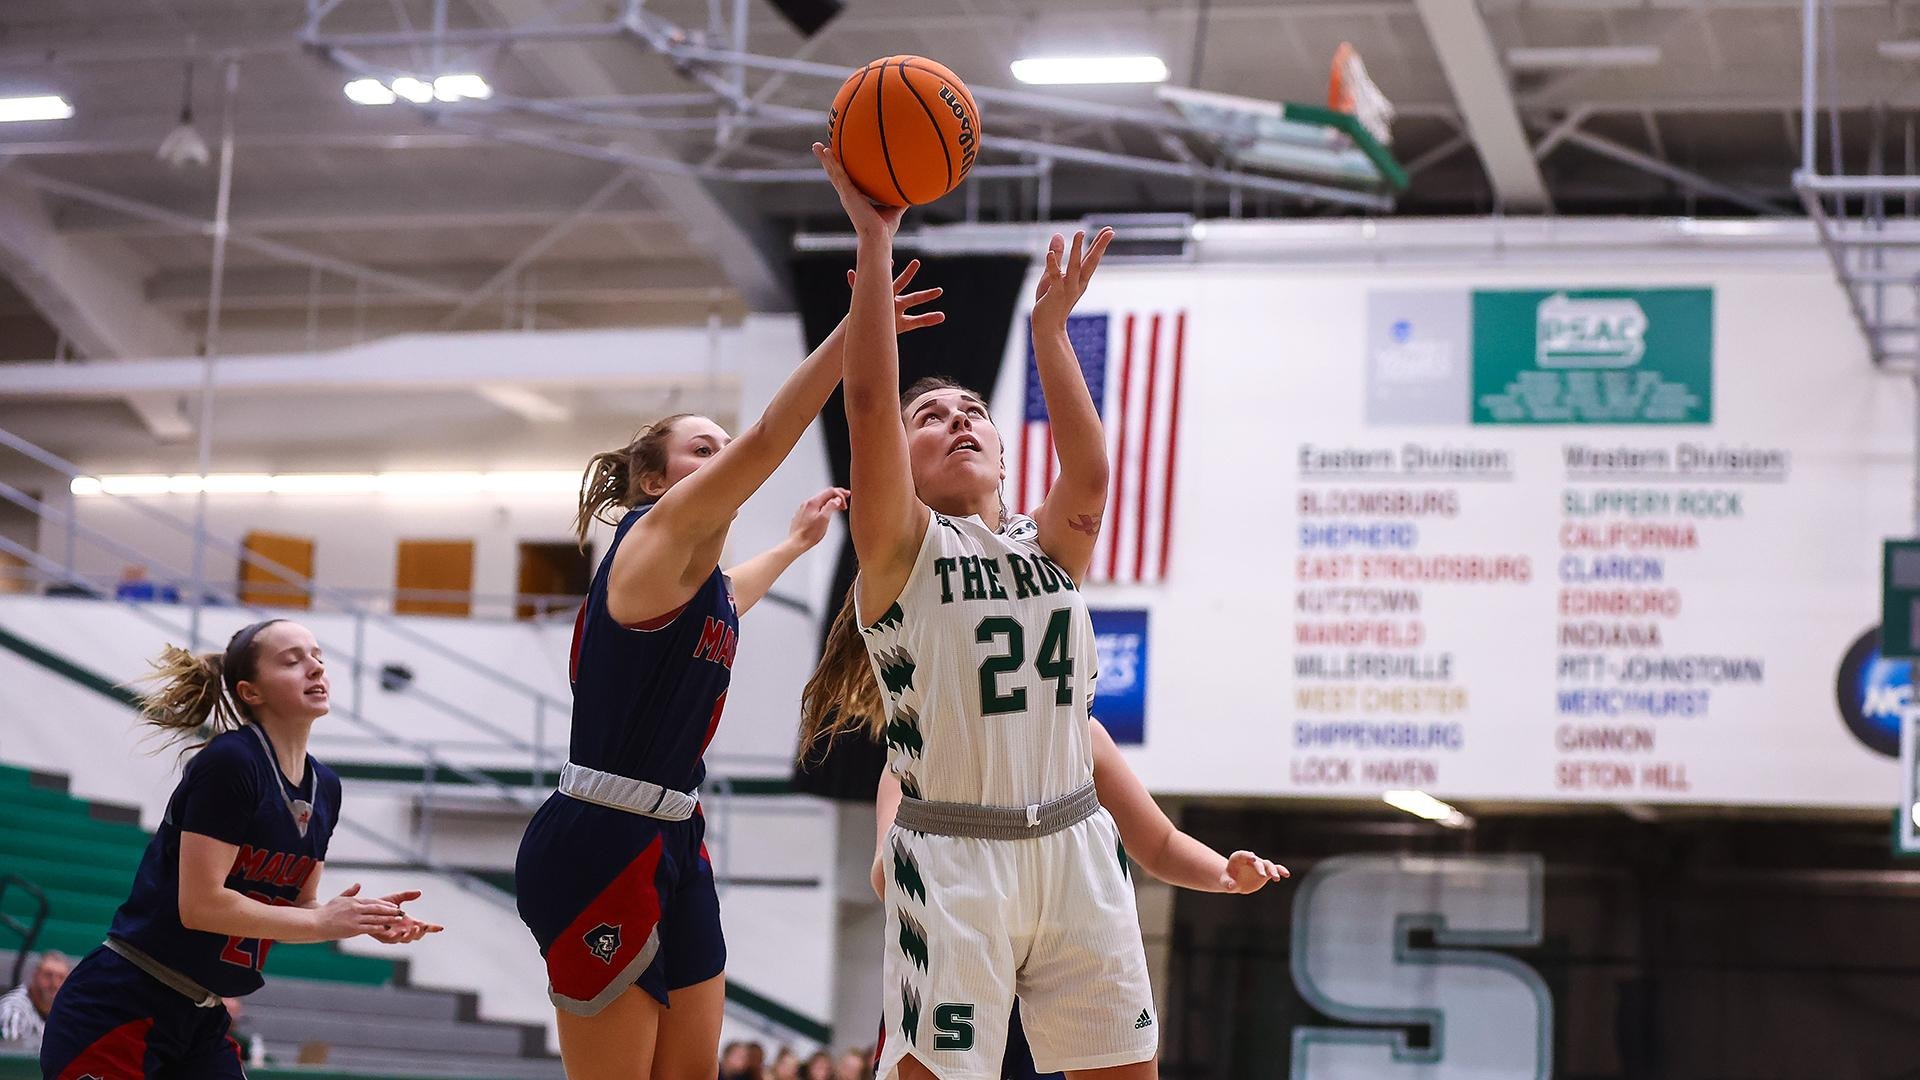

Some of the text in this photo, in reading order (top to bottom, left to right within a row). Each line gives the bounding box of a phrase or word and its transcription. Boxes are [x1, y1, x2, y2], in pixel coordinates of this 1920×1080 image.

[1299, 446, 1393, 469] Eastern
[1564, 447, 1669, 469] Western
[1299, 492, 1458, 516] BLOOMSBURG
[1564, 491, 1741, 517] SLIPPERY ROCK
[1300, 524, 1416, 548] SHEPHERD
[1562, 524, 1697, 549] CALIFORNIA
[934, 552, 1074, 604] THE ROC
[1297, 556, 1353, 579] EAST
[1562, 556, 1663, 581] CLARION
[1560, 590, 1679, 616] EDINBORO
[1558, 623, 1661, 648] INDIANA
[974, 606, 1074, 717] 24
[1297, 688, 1466, 711] WEST CHESTER
[1557, 726, 1654, 752] GANNON
[1292, 759, 1437, 785] LOCK HAVEN
[1558, 763, 1689, 791] SETON HILL
[1289, 853, 1554, 1080] S
[933, 1003, 975, 1050] S
